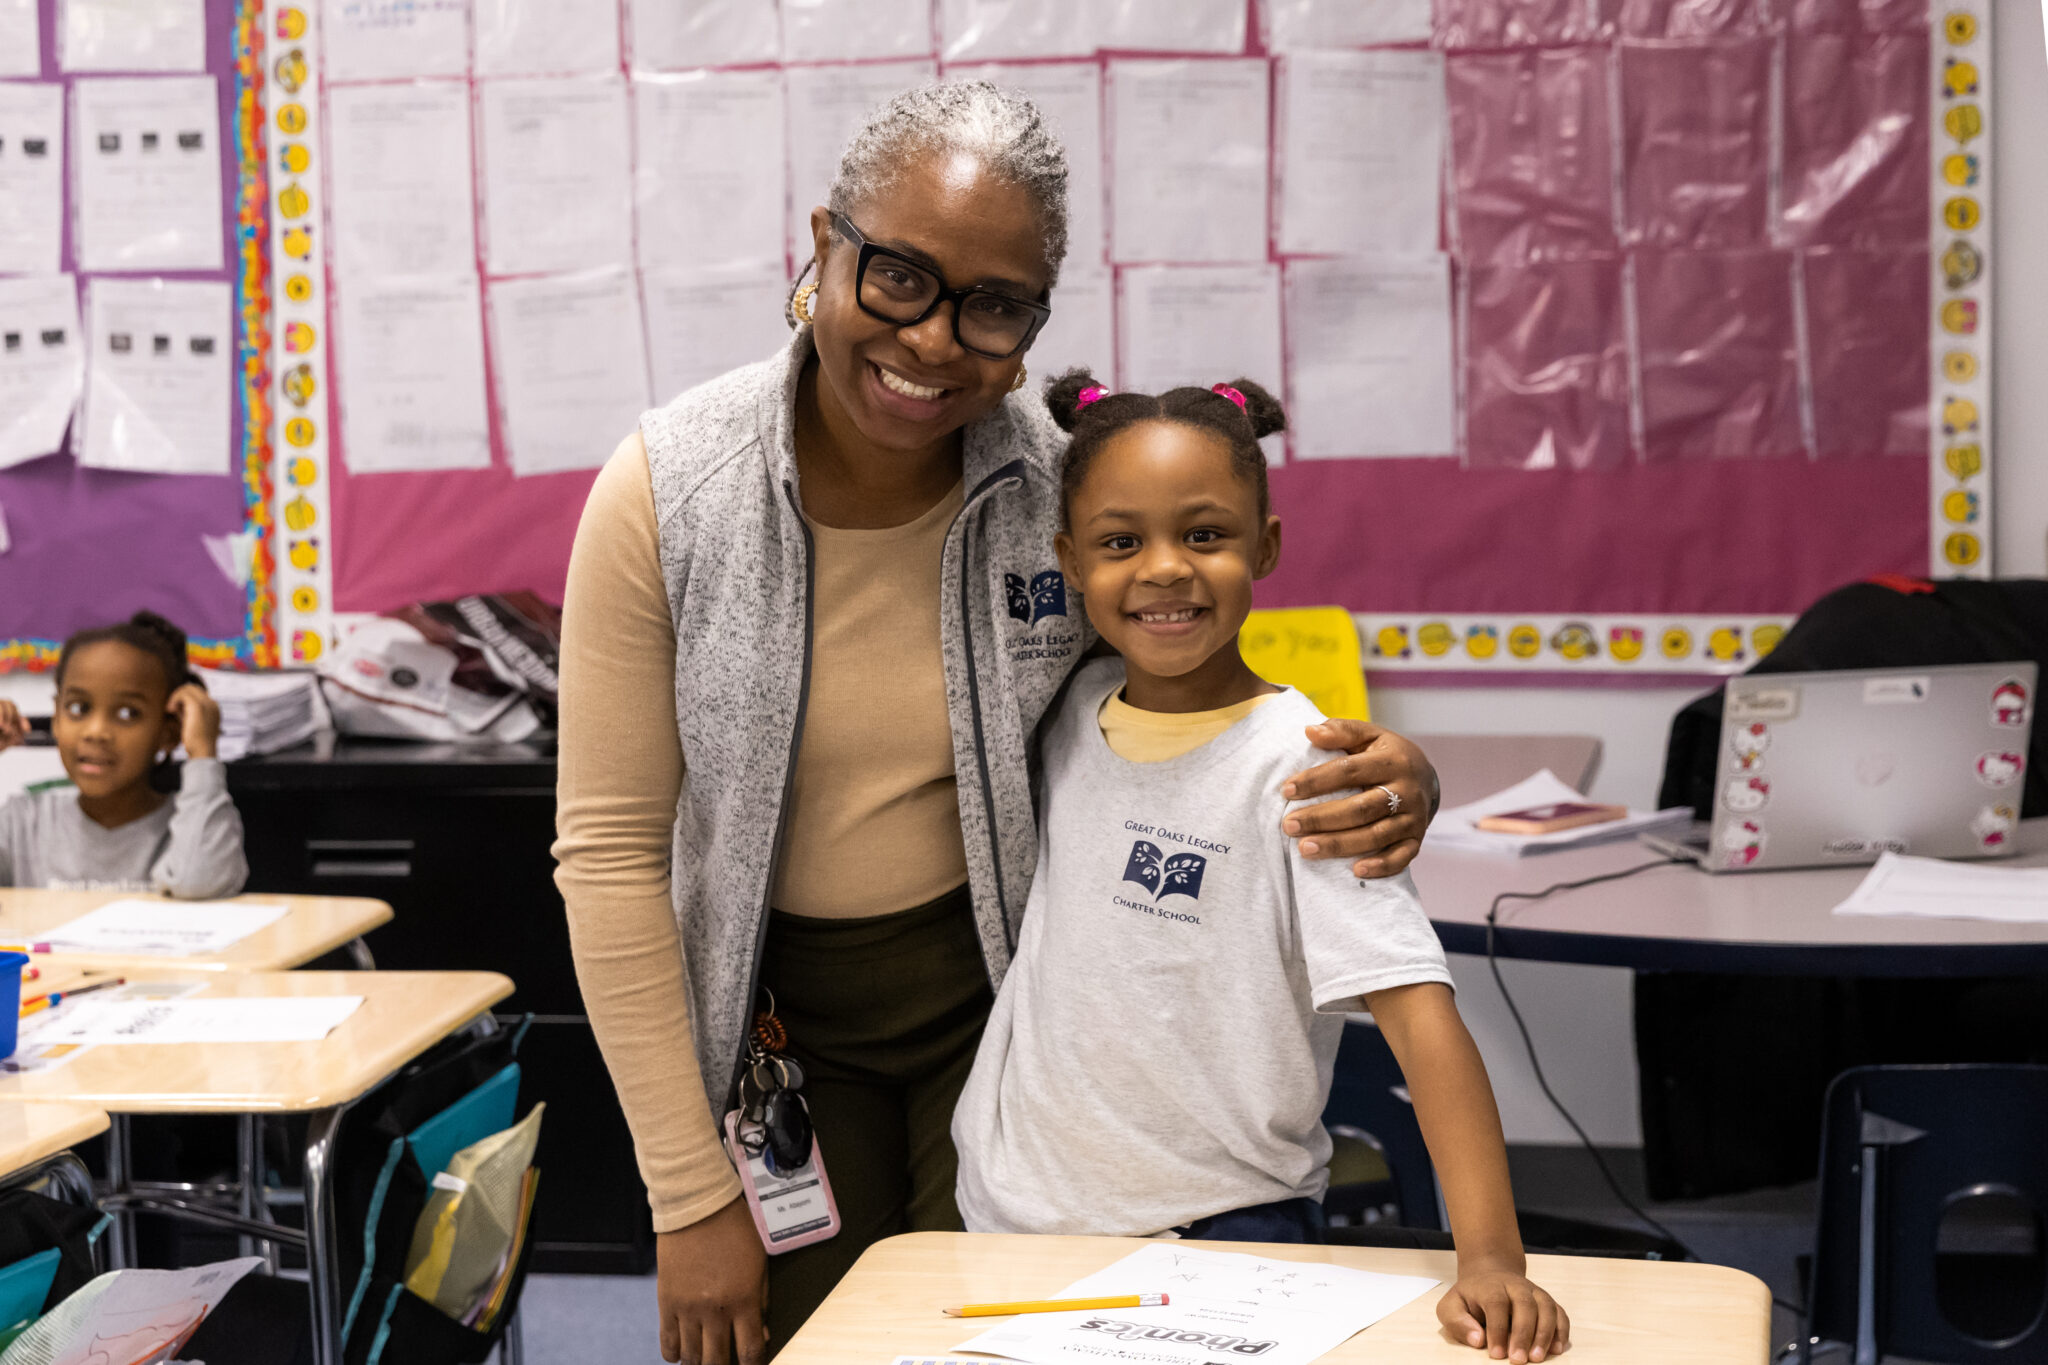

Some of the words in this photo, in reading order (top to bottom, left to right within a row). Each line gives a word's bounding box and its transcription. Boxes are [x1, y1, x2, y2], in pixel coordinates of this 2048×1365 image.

[1124, 820, 1156, 835] GREAT
[1157, 827, 1185, 843] OAKS
[1187, 835, 1231, 854] LEGACY
[1113, 895, 1155, 915] CHARTER
[1157, 908, 1202, 924] SCHOOL
[1080, 1317, 1279, 1355] Phonics
